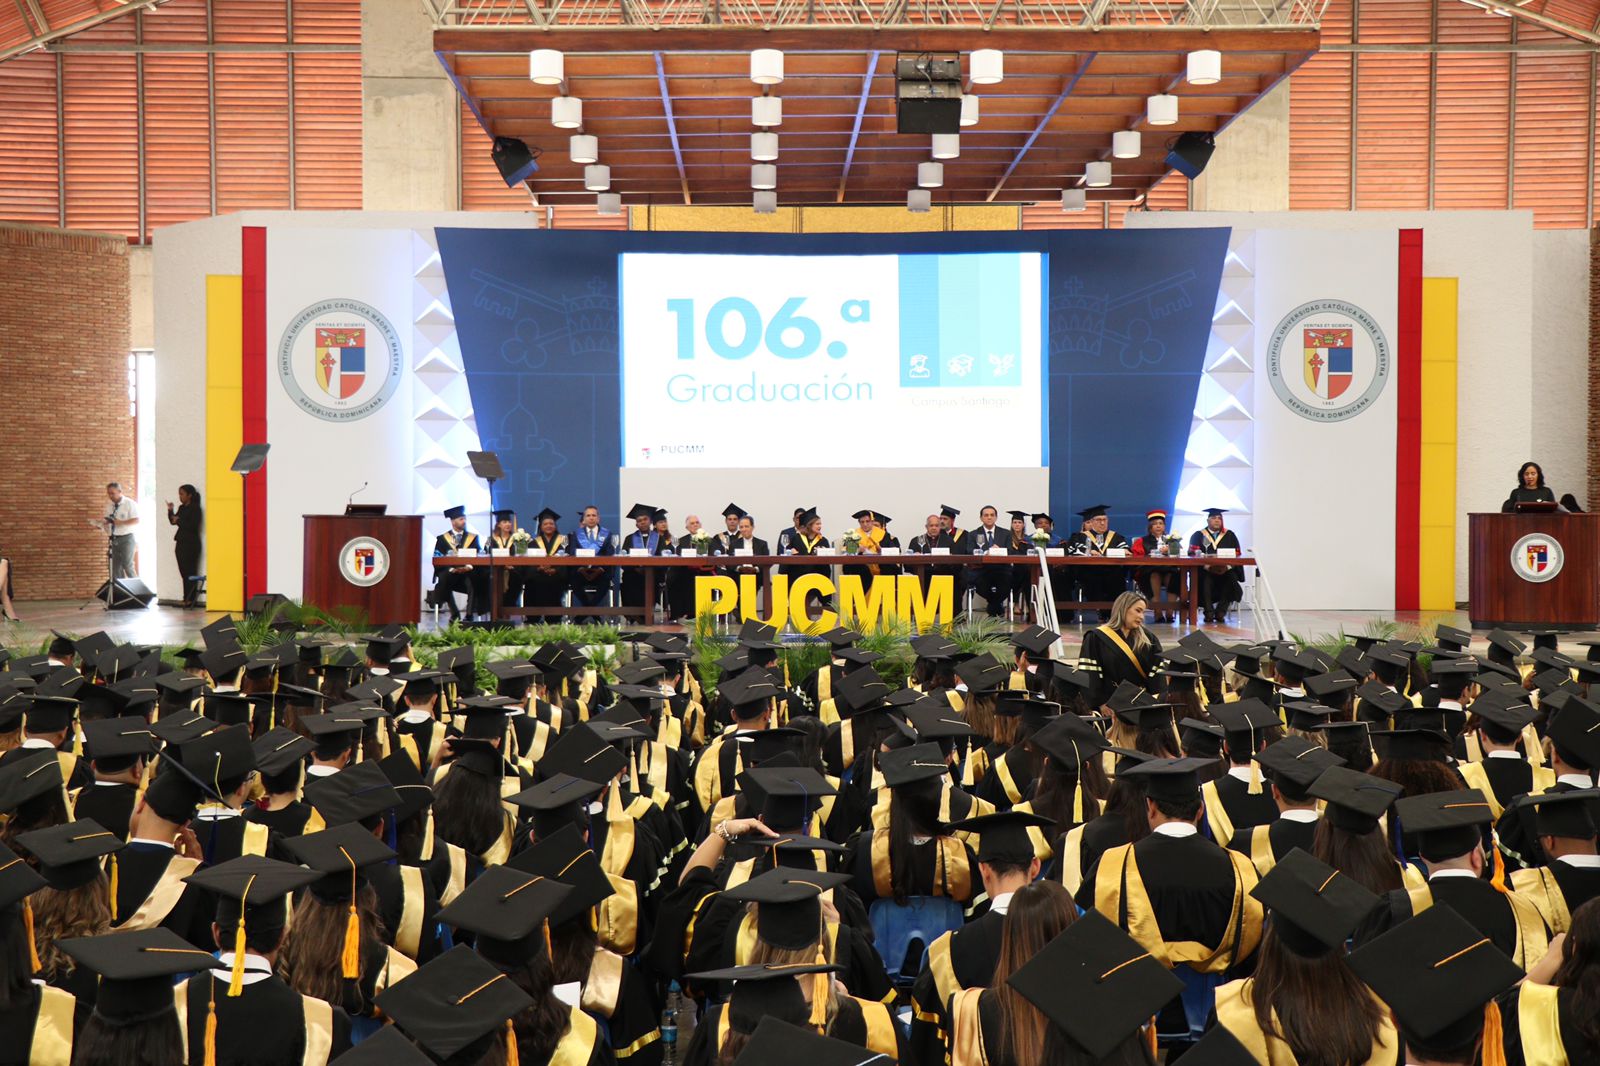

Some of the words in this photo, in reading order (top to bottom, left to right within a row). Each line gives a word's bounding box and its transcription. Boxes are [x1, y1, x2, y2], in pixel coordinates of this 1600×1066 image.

[283, 335, 293, 376] PONTIFICIA
[291, 303, 332, 334] UNIVERSIDAD
[371, 313, 391, 334] MADRE
[391, 342, 399, 376] MAESTRA
[1272, 337, 1281, 377] PONTIFICIA
[1280, 304, 1320, 335] UNIVERSIDAD
[1358, 314, 1378, 334] MADRE
[1378, 342, 1386, 377] MAESTRA
[666, 372, 873, 403] Graduación
[340, 397, 383, 418] DOMINICANA
[1327, 397, 1370, 418] DOMINICANA
[661, 445, 704, 454] PUCMM
[694, 573, 955, 636] PUCMM
